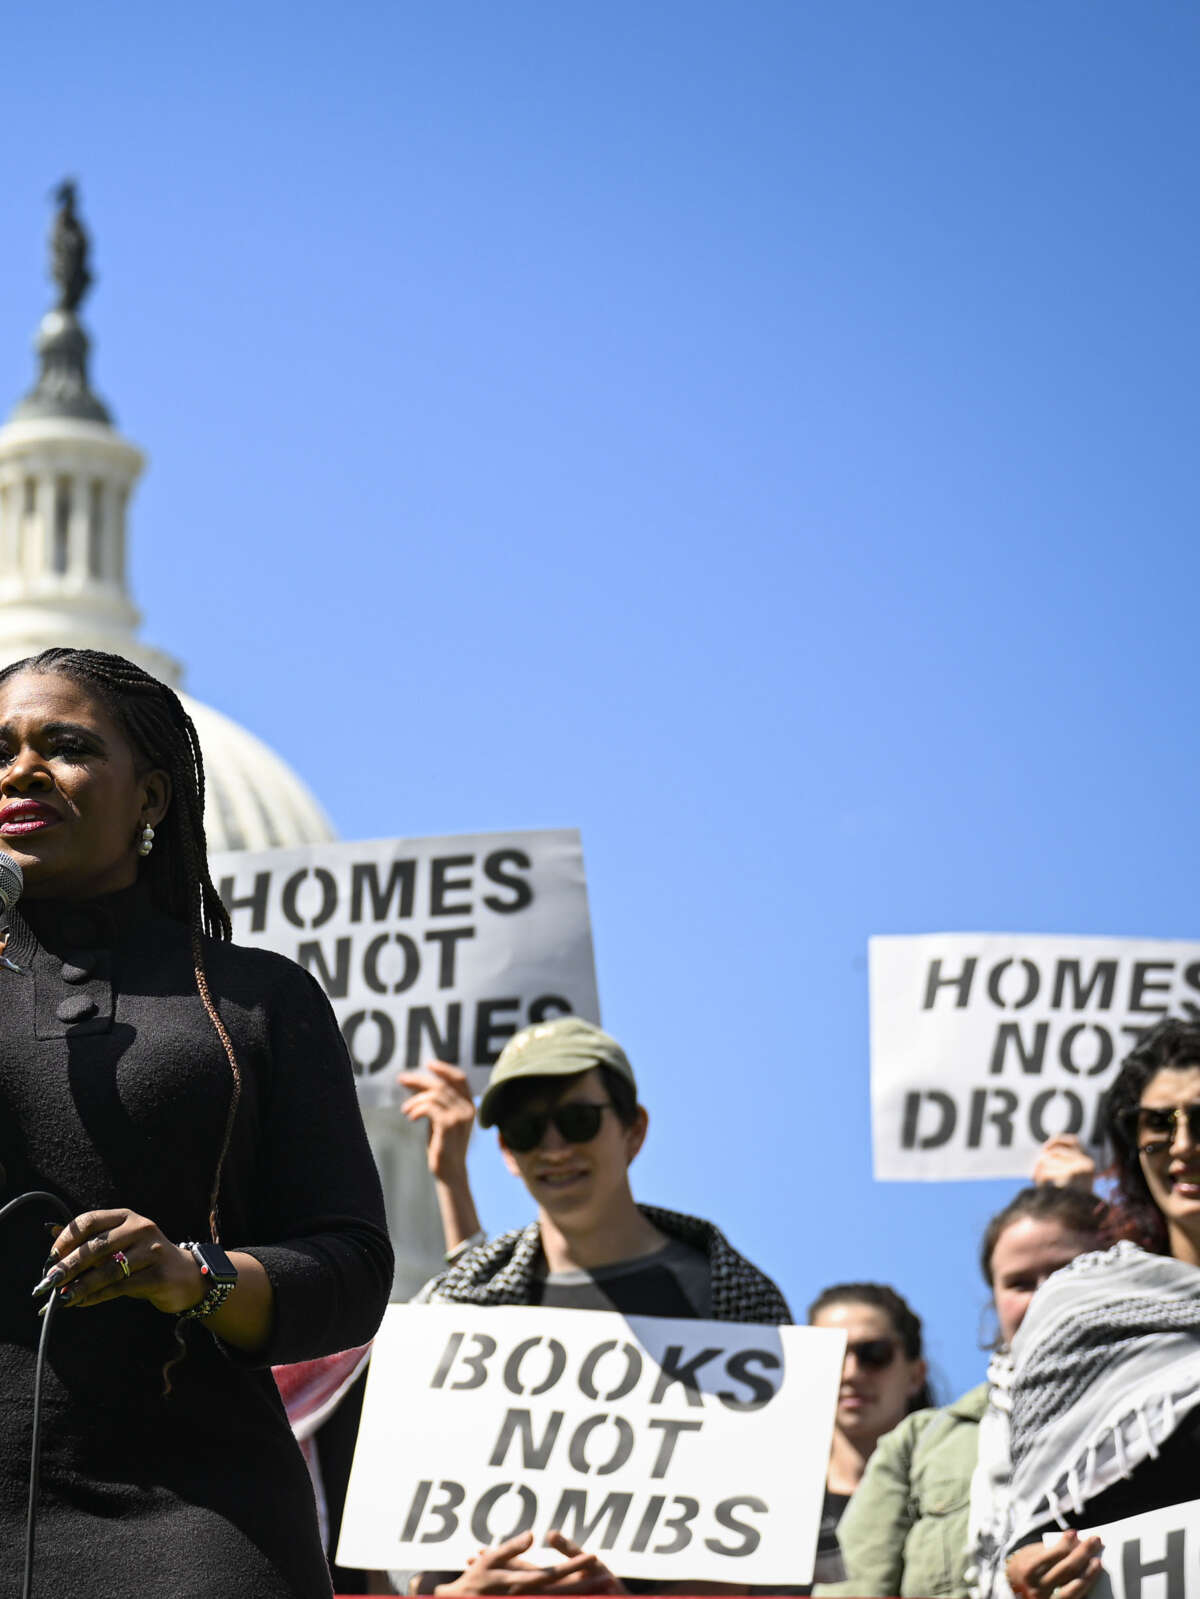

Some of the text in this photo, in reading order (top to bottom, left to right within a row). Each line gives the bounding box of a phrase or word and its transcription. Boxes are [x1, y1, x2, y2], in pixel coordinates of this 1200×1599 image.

[220, 848, 535, 934] HOMES
[299, 926, 475, 999] NOT
[342, 994, 573, 1077] ONE
[900, 1086, 1110, 1150] DRO
[430, 1331, 782, 1413] BOOKS
[489, 1408, 704, 1479] NOT
[399, 1480, 769, 1558] BOMBS
